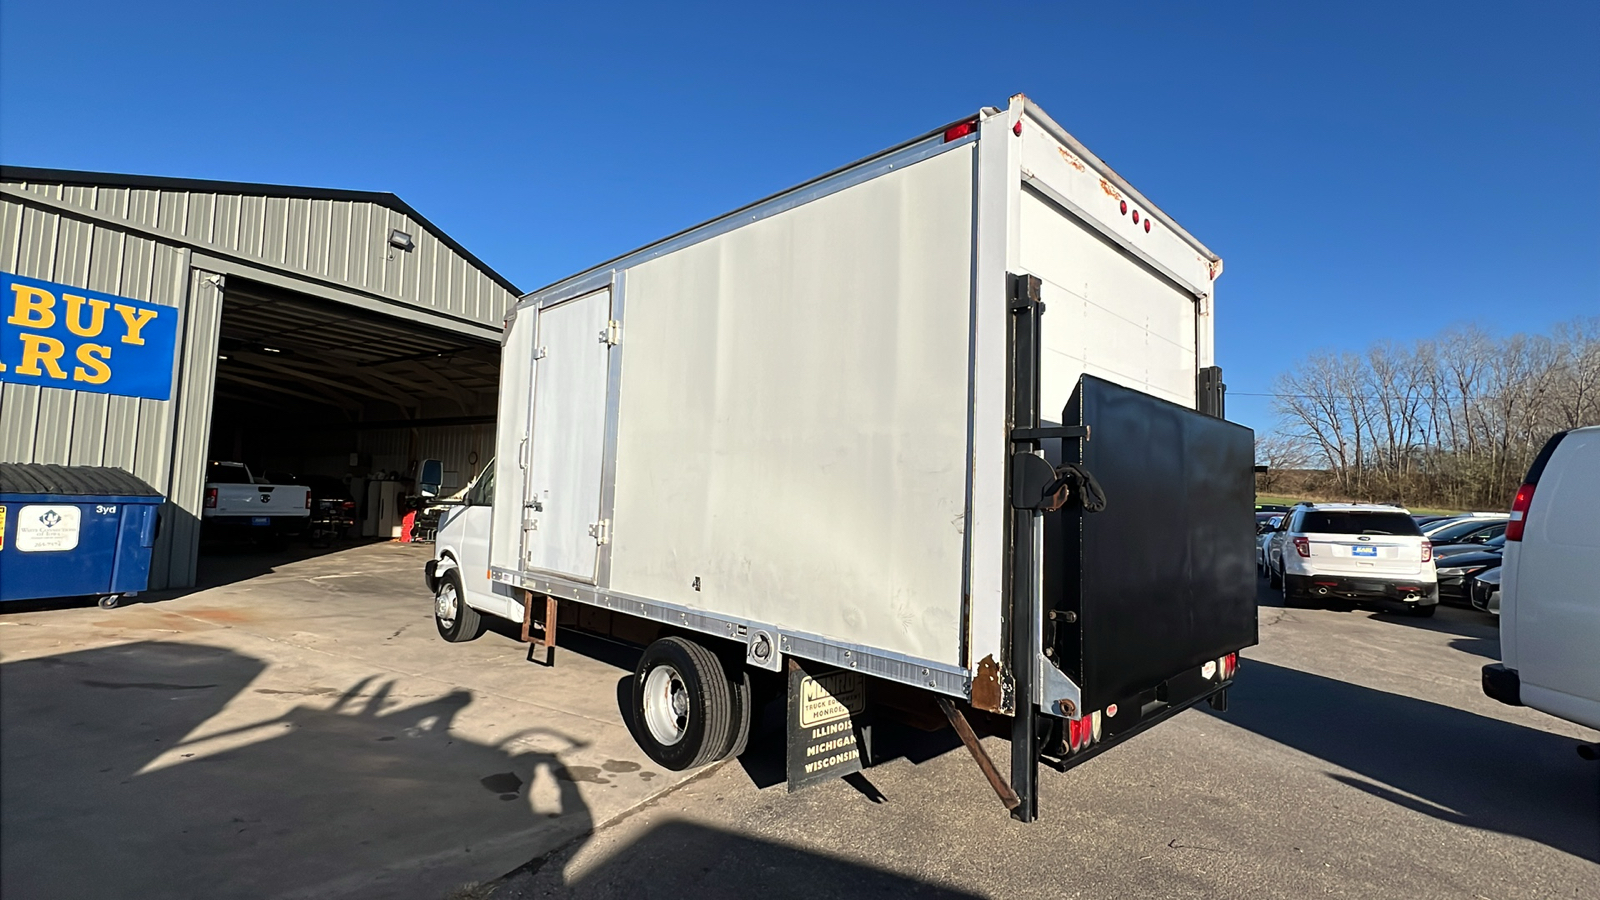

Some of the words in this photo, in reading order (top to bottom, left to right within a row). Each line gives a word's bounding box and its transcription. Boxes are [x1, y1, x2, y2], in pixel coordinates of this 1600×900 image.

[7, 283, 158, 346] BUY
[0, 333, 112, 385] RS
[96, 505, 117, 515] 3yd
[805, 701, 826, 712] TRUCK
[812, 720, 853, 739] ILLINOIS
[806, 734, 857, 757] MICHIGAN
[805, 748, 860, 774] WISCONSIN
